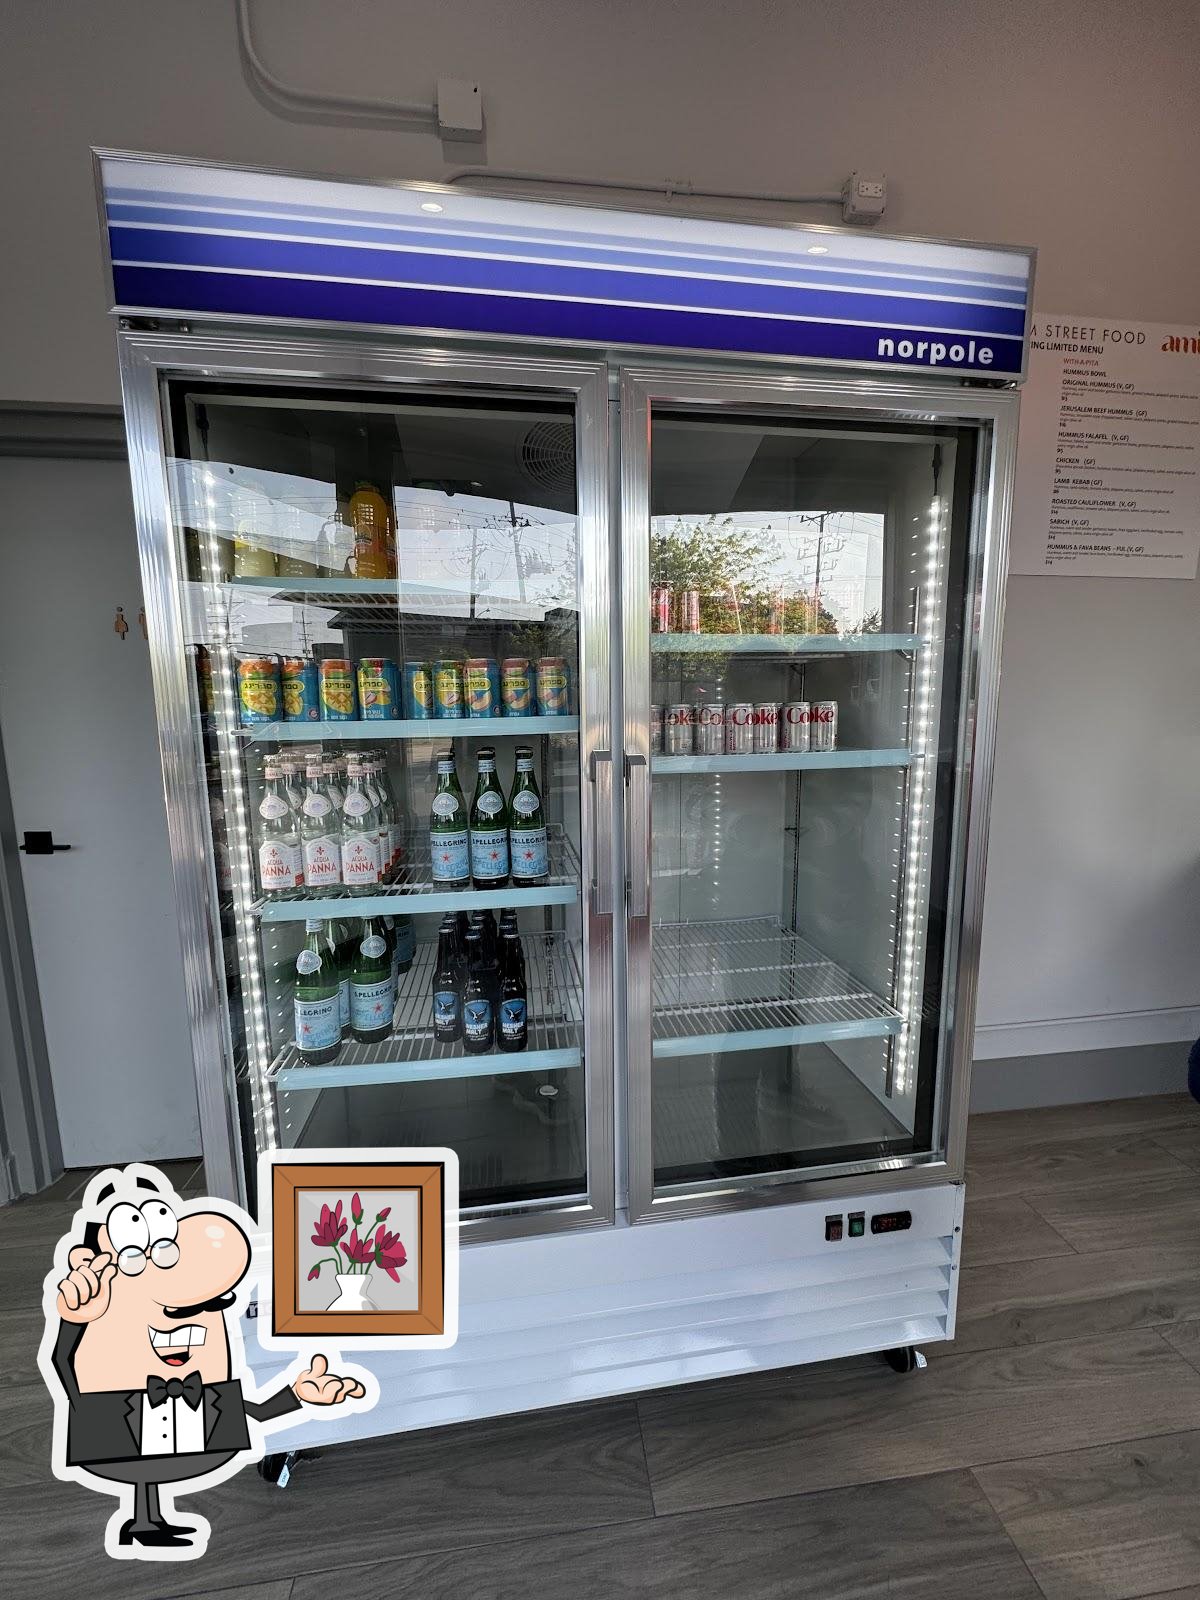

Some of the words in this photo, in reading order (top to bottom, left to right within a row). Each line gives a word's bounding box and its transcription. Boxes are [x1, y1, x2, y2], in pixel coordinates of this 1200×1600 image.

[1045, 324, 1096, 341] STREET
[1102, 328, 1146, 345] FOOD
[877, 338, 994, 365] norpole
[1030, 340, 1045, 350] ING
[1046, 342, 1079, 353] LIMITED
[1079, 344, 1104, 355] MENU
[1063, 368, 1089, 376] HUMMUS
[1062, 379, 1089, 387] ORIGINAL
[1089, 381, 1116, 389] HUMMUS
[1060, 405, 1093, 413] JERUSALEM
[1107, 408, 1133, 416] HUMMUS
[1058, 431, 1085, 439] HUMMUS
[1077, 499, 1116, 507] CAULIFLOWER
[262, 866, 292, 877] PANNA
[307, 862, 337, 874] PANNA
[345, 861, 375, 873] PANNA
